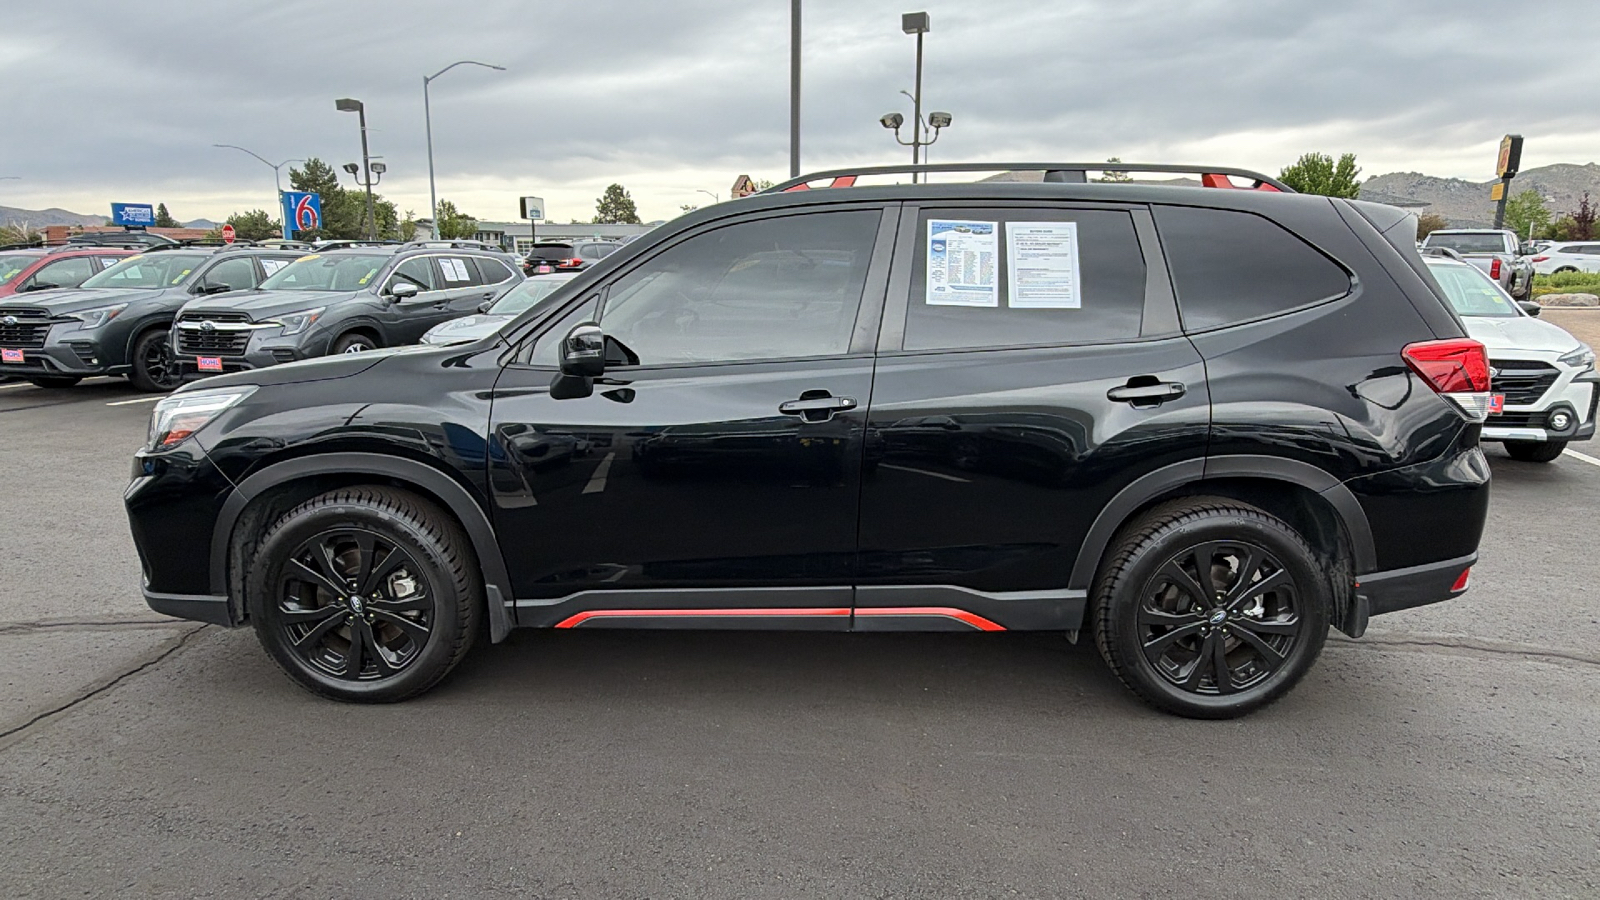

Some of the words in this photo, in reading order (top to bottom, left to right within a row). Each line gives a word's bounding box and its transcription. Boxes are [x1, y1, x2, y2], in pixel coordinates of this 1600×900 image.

[296, 194, 319, 231] 6
[223, 230, 235, 238] STOP
[201, 358, 220, 366] HOHL
